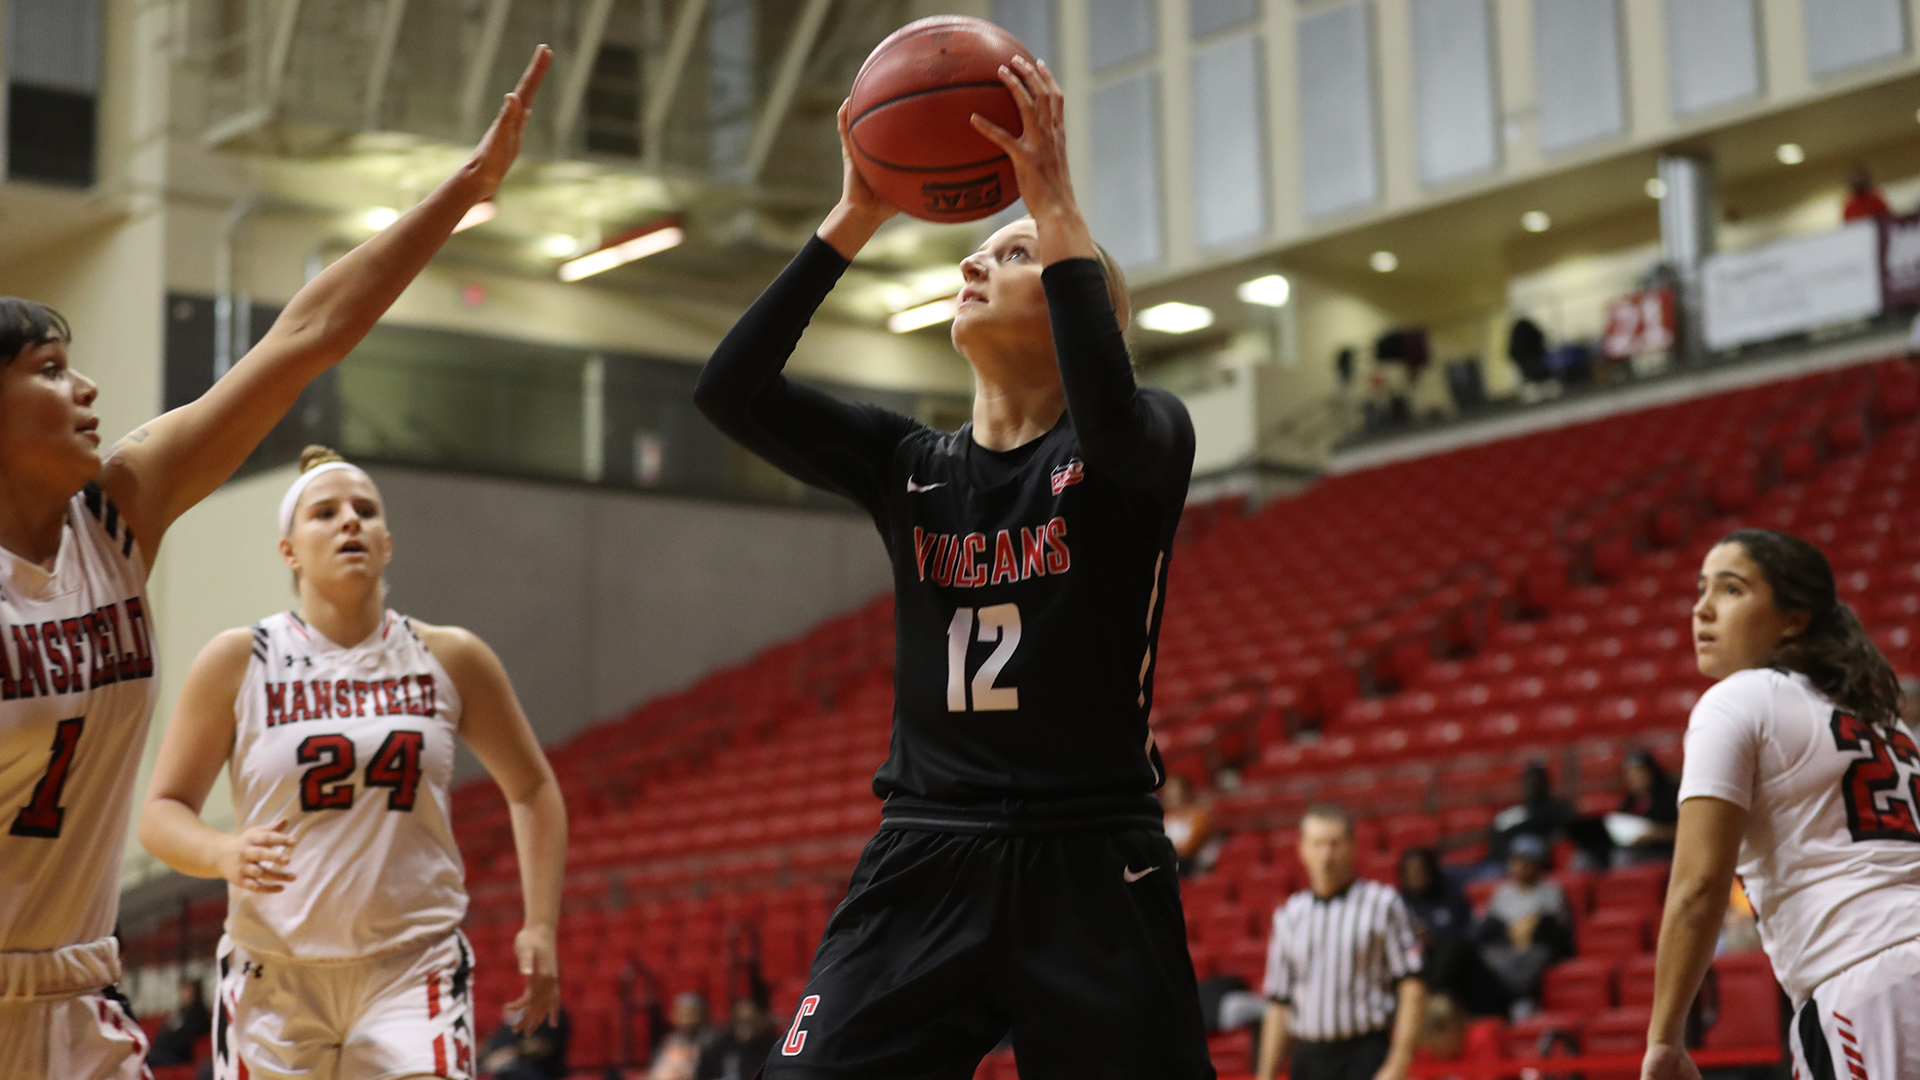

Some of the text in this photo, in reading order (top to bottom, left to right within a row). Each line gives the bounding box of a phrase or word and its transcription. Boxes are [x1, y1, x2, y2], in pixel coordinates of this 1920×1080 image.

[913, 516, 1071, 588] VULCANS
[946, 602, 1022, 712] 12
[265, 674, 437, 727] MANSFIELD
[9, 717, 85, 838] 1
[297, 730, 424, 812] 24
[781, 994, 820, 1056] C
